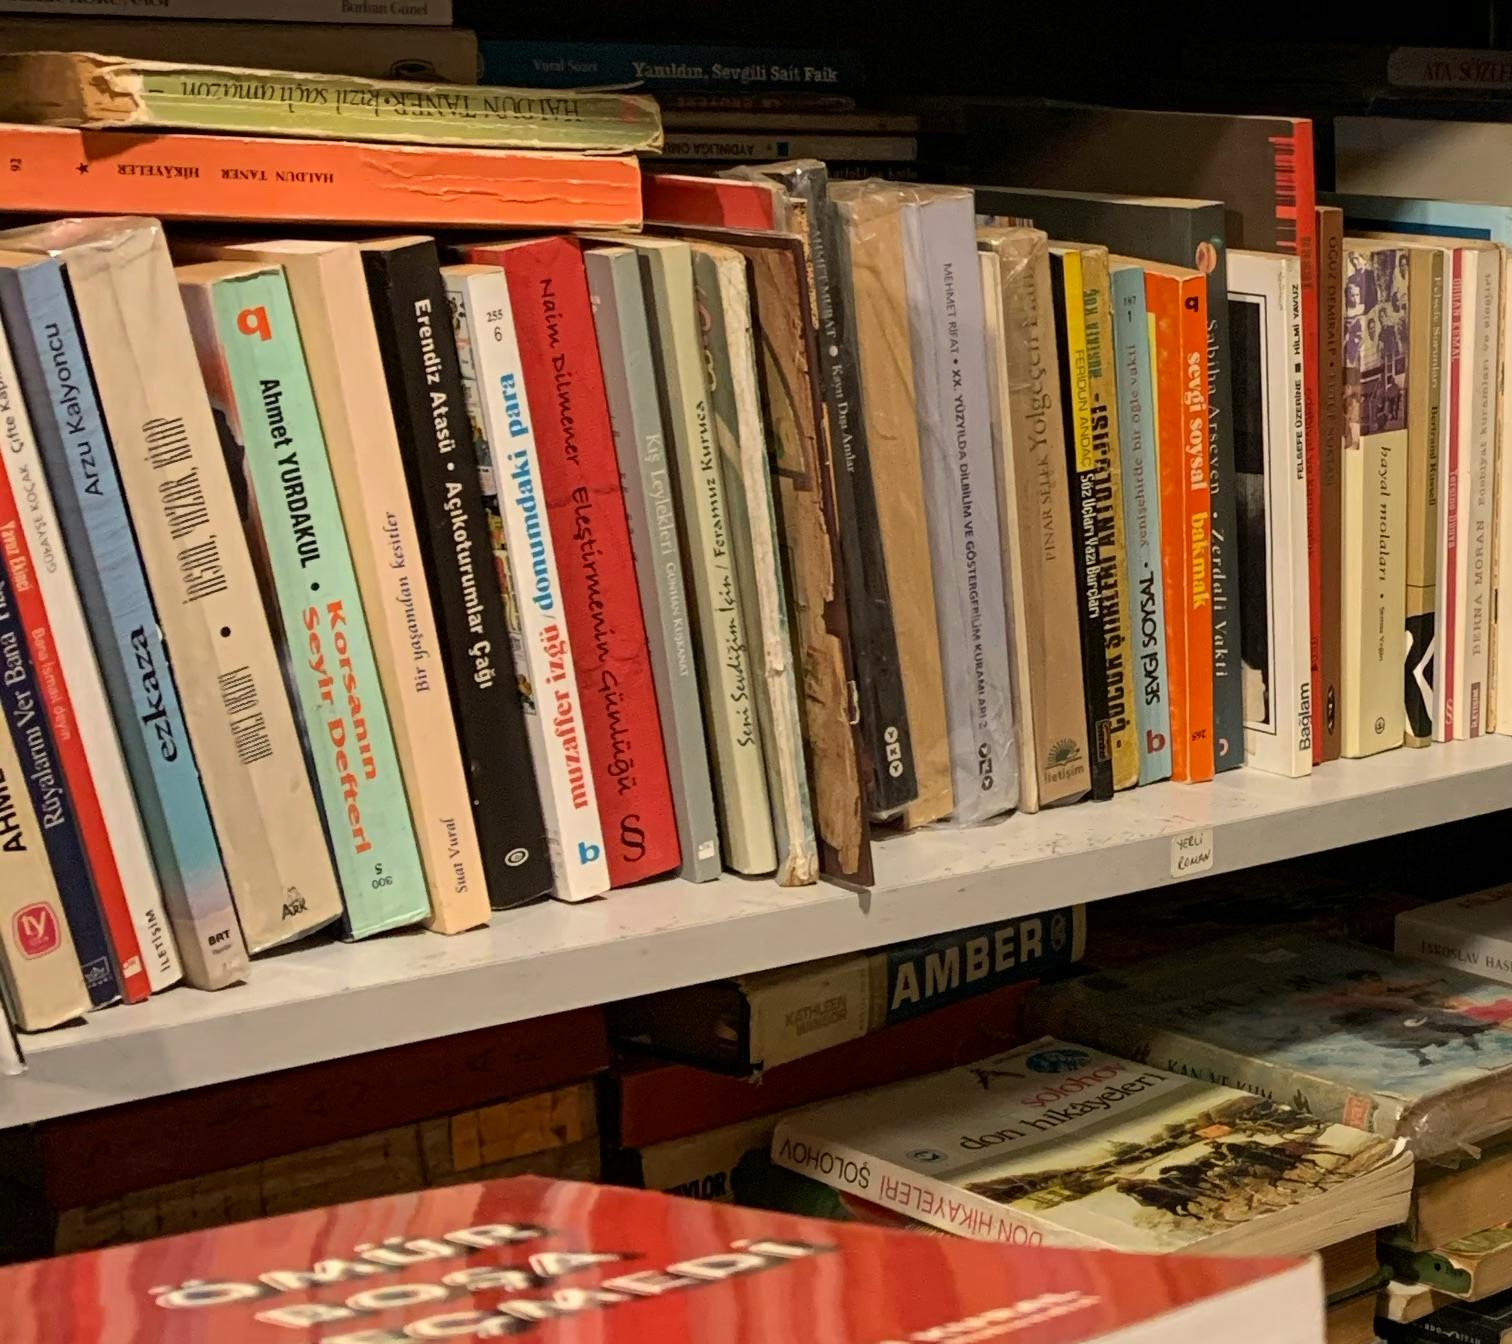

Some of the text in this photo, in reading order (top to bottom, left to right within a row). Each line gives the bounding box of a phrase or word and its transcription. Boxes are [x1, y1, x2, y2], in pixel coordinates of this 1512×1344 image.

[942, 261, 957, 321] MEHMET
[44, 321, 105, 496] Arzu Kalyoncu
[259, 378, 321, 569] Ahmet YURDAKUL
[413, 297, 493, 689] Erendiz Atasü Açıkoturumlar Çağı
[1185, 350, 1209, 611] sevgi soysal bakmak
[499, 371, 588, 809] muzaffer izgü donumdaki para
[537, 276, 633, 795] Naim Dilmener Eleştirmenin Günlüğü
[129, 623, 179, 763] ezkaza
[302, 606, 372, 855] Seyir Defteri
[325, 600, 376, 781] Korsanın
[1296, 680, 1311, 752] Bağlam
[1176, 833, 1208, 853] YERLİ
[1177, 853, 1212, 872] ROMAN
[891, 916, 1042, 1011] AMBER
[958, 1070, 1169, 1152] don hikâyeleri
